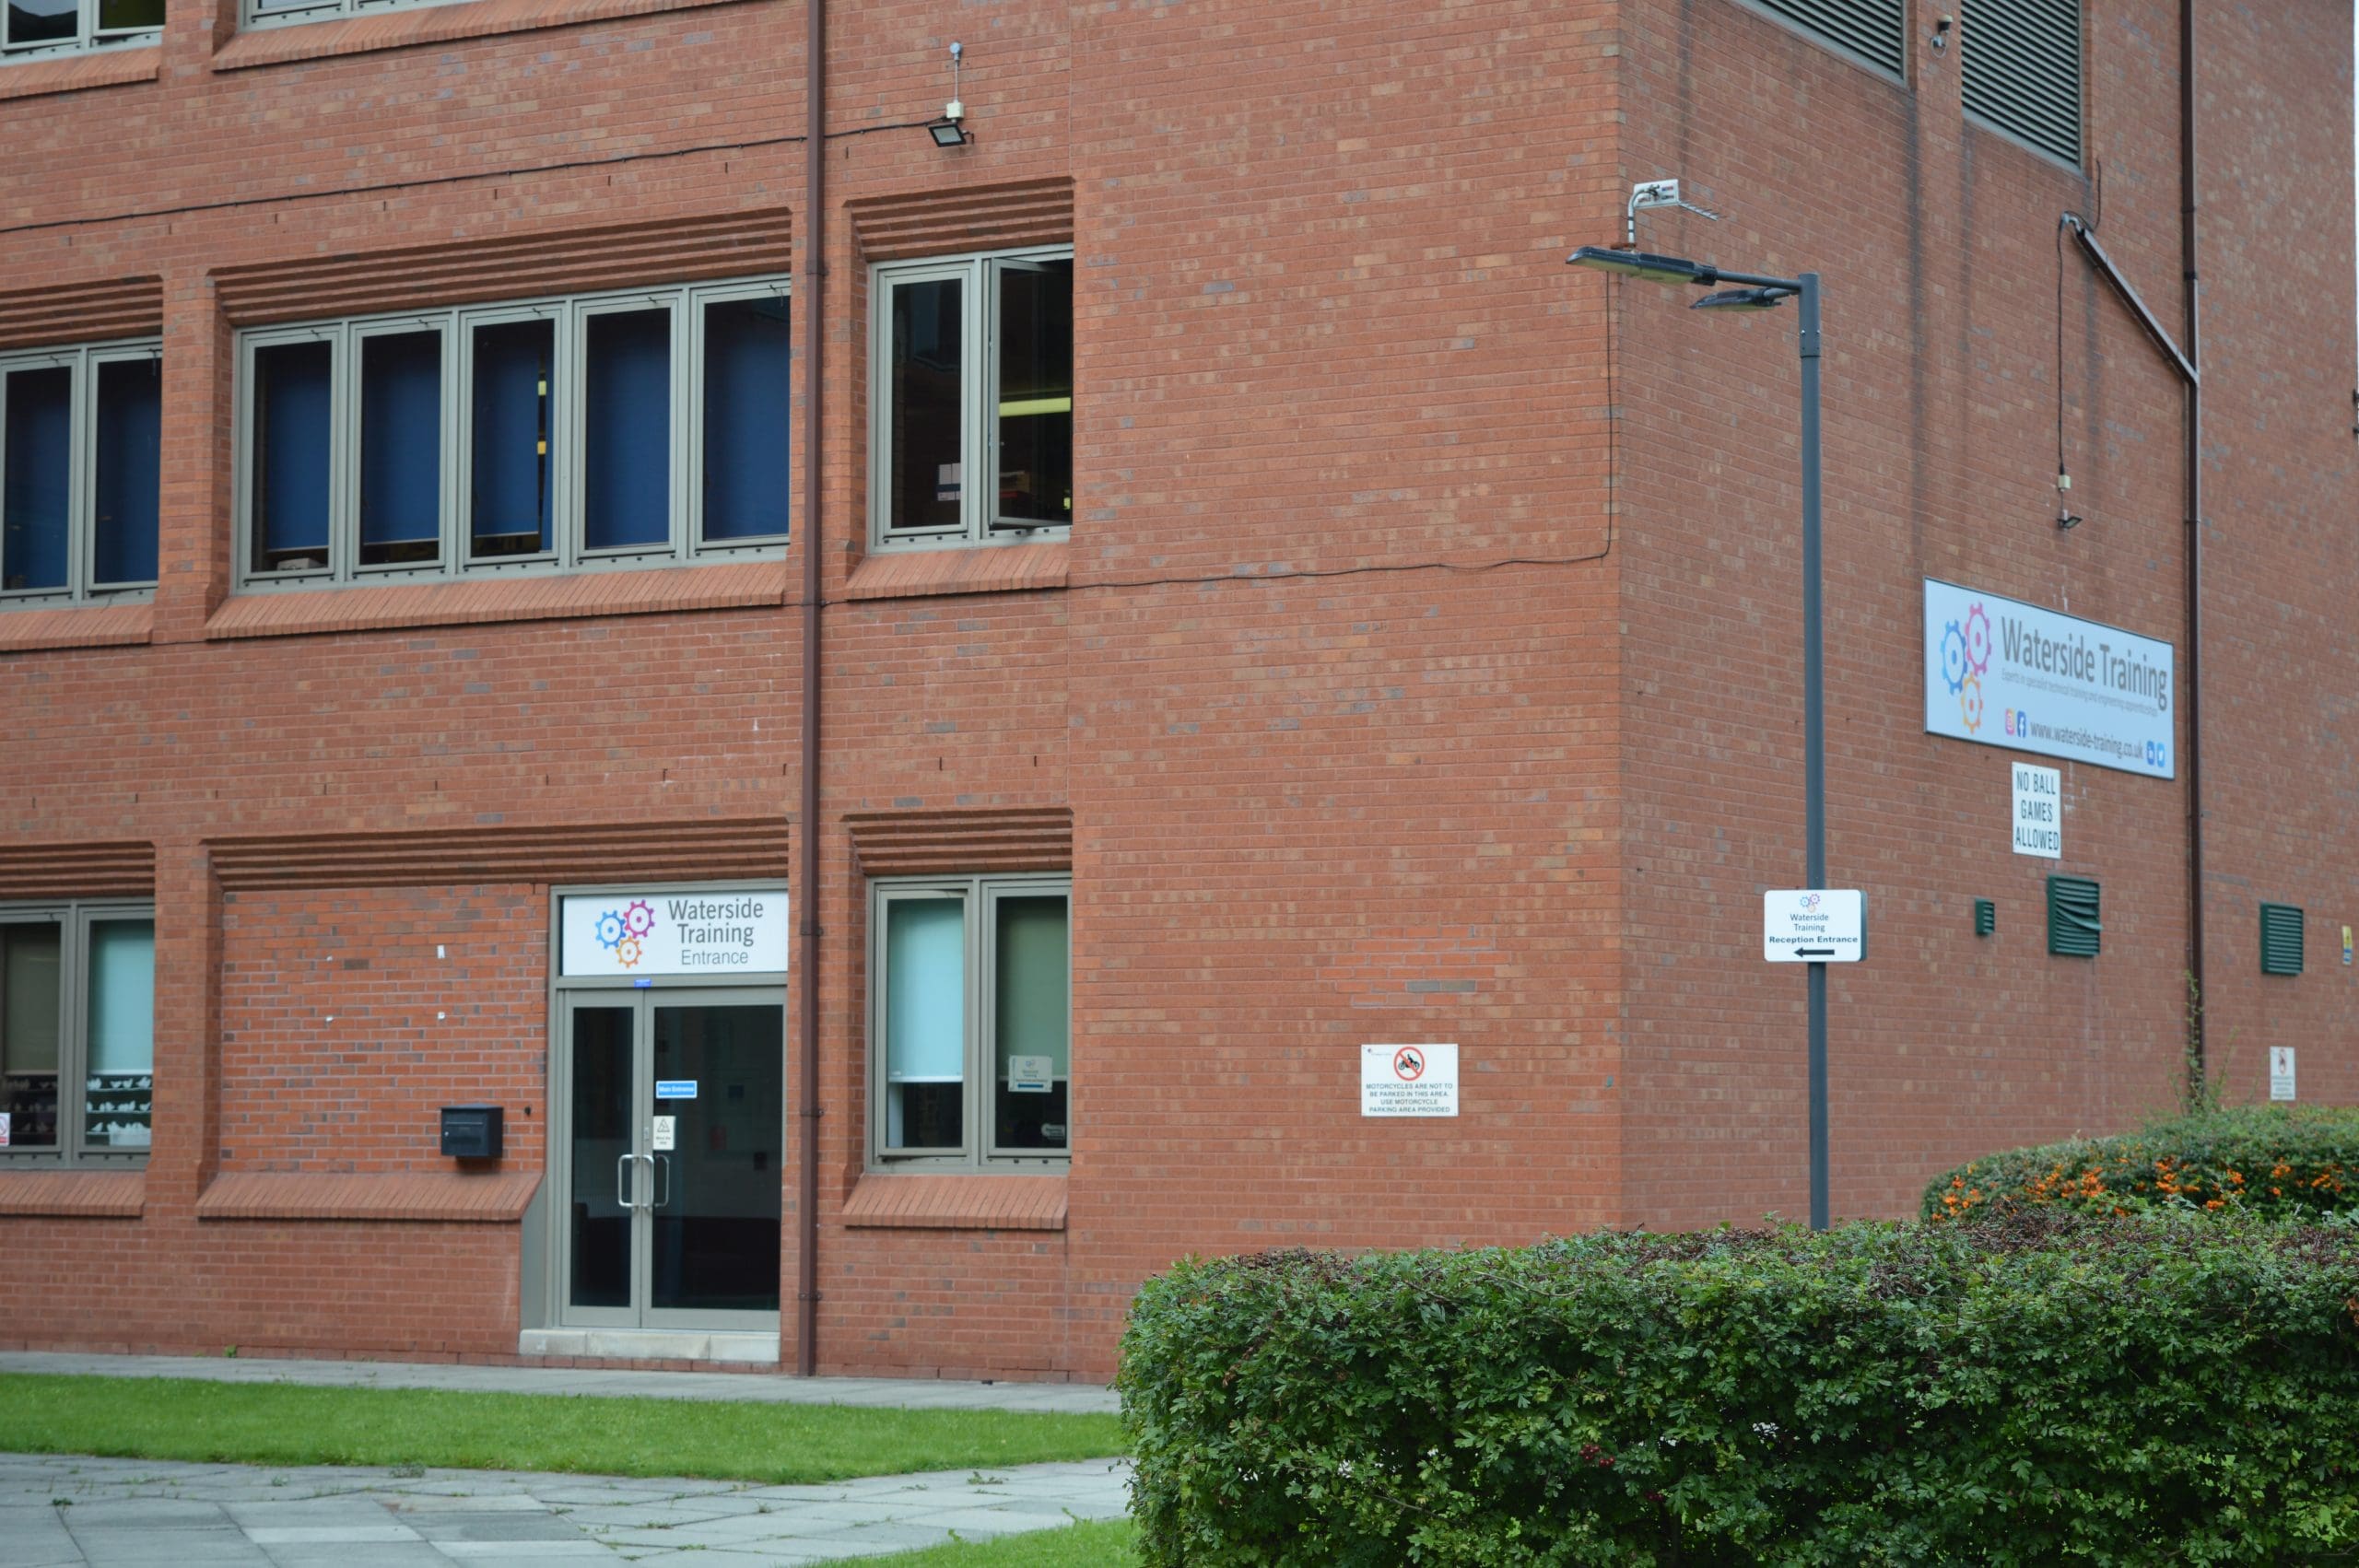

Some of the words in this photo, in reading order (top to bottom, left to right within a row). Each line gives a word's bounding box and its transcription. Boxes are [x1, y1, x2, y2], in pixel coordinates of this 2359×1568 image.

[2001, 615, 2095, 683] Waterside
[2099, 644, 2167, 711] Training
[2030, 721, 2143, 759] www.waterside-training.co.uk
[2016, 771, 2029, 791] NO
[2033, 773, 2056, 795] BALL
[2021, 800, 2053, 823] GAMES
[2015, 826, 2060, 850] ALLOWED
[667, 897, 764, 920] Waterside
[1790, 913, 1829, 921] Waterside
[677, 923, 755, 947] Training
[1794, 923, 1825, 932] Training
[1769, 936, 1814, 944] Reception
[1817, 935, 1858, 943] Entrance
[681, 949, 748, 965] Entrance
